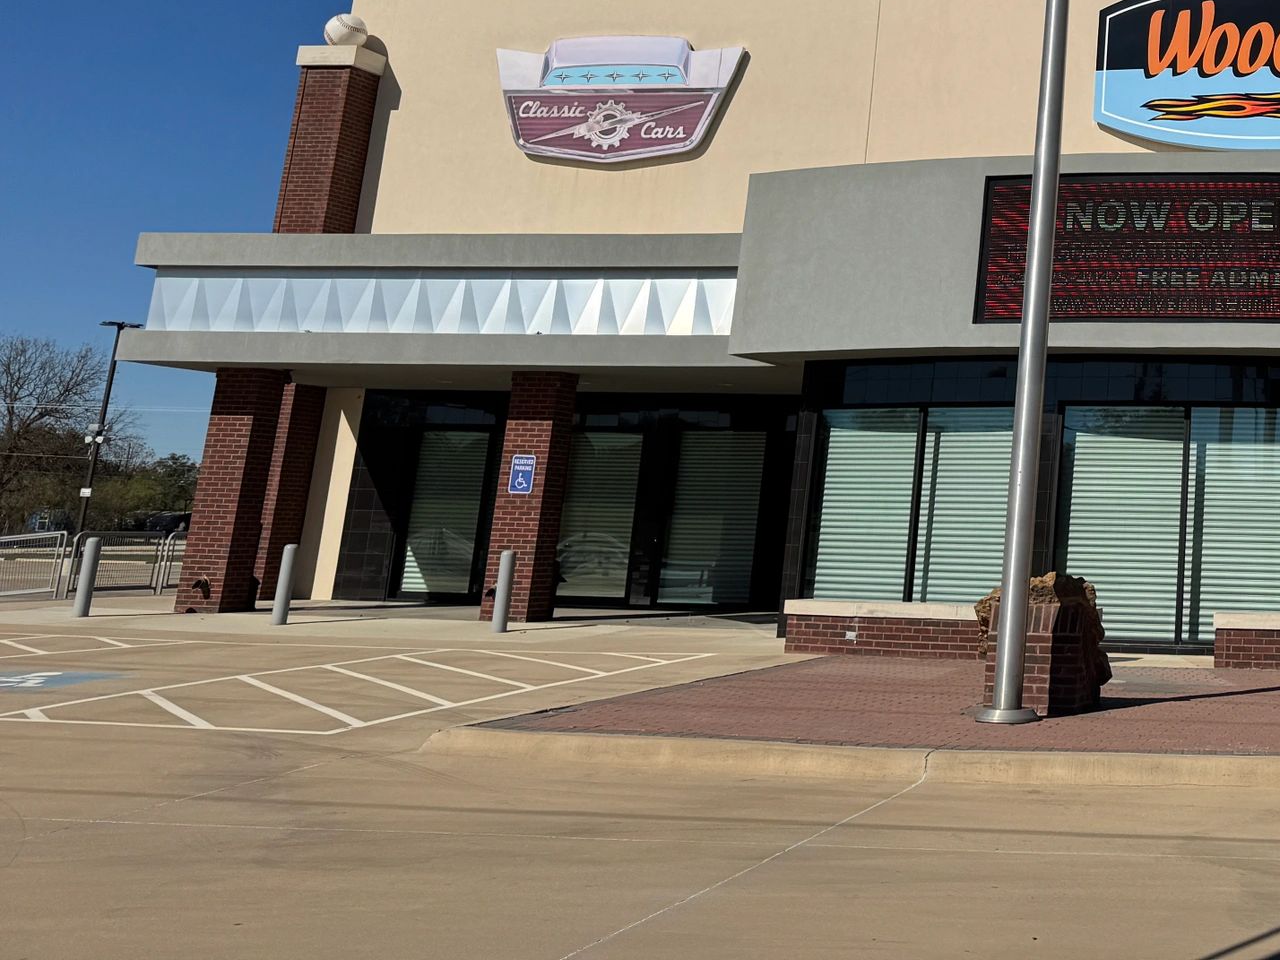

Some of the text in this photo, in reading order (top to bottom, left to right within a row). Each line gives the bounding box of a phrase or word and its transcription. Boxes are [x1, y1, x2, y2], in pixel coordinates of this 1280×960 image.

[519, 100, 587, 118] Classic
[640, 121, 687, 139] Cars
[1065, 200, 1173, 232] NOW
[1136, 268, 1200, 287] FREE
